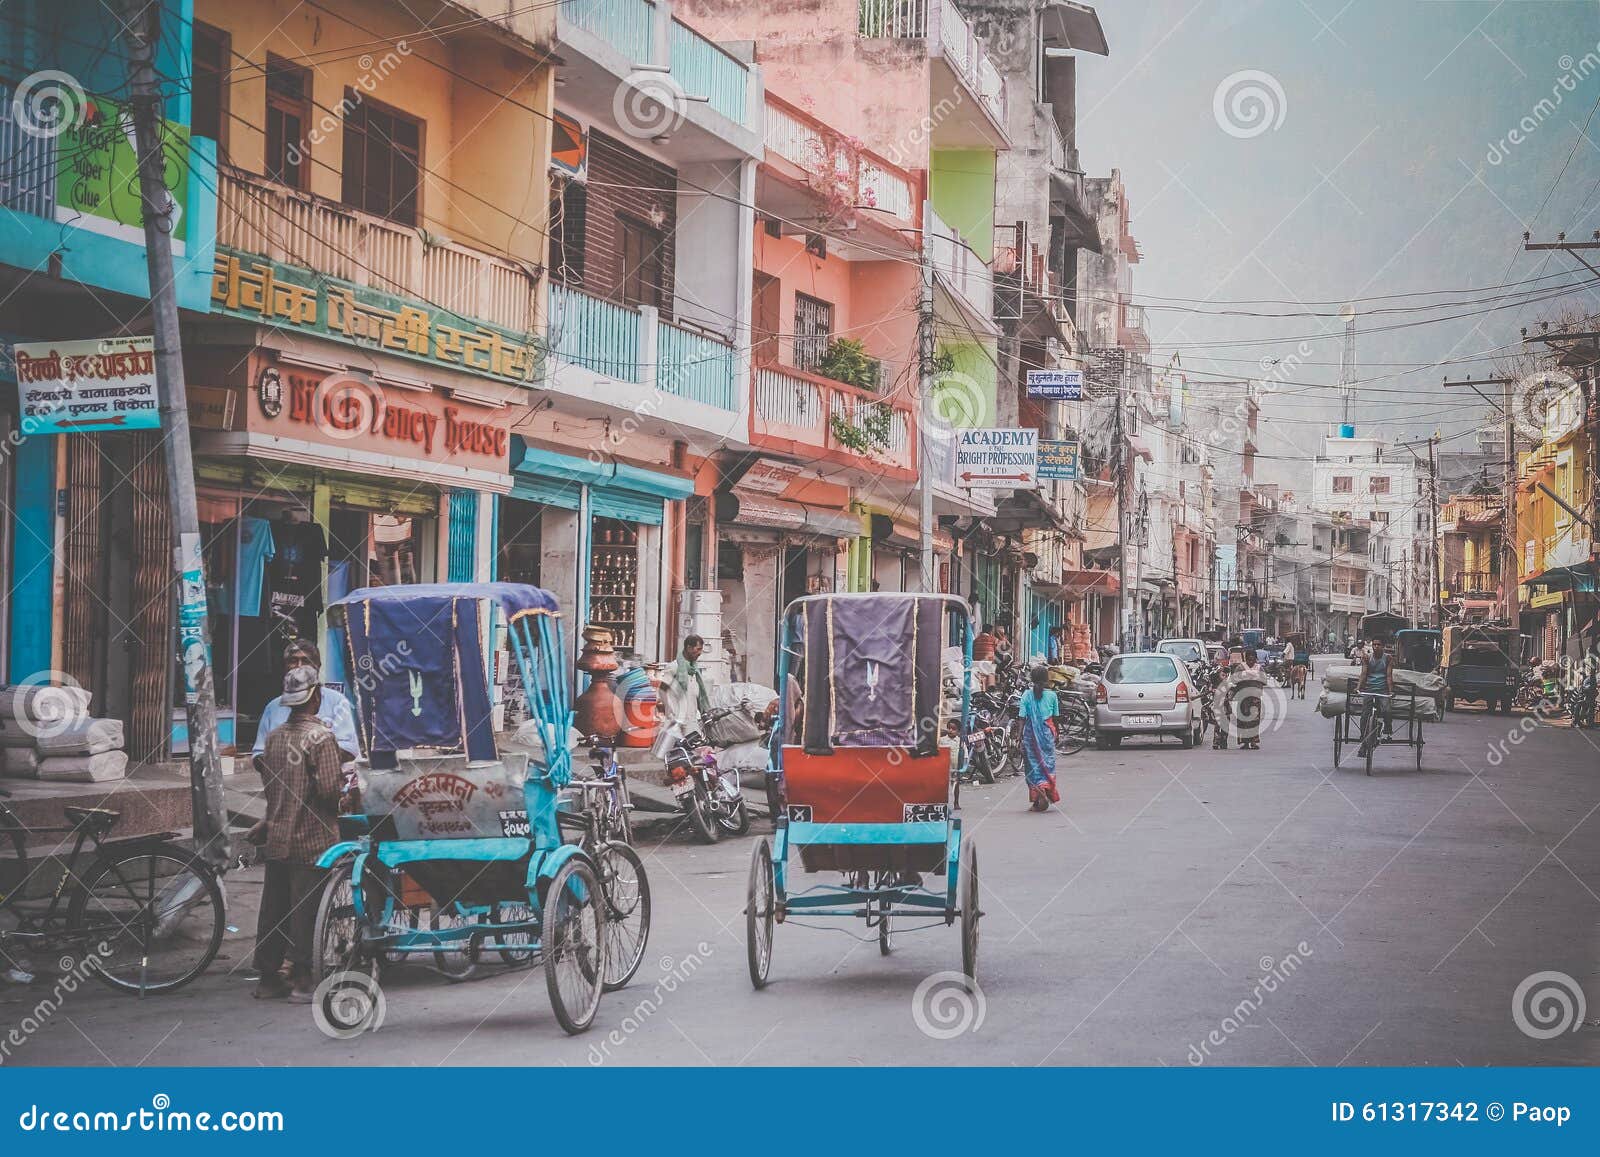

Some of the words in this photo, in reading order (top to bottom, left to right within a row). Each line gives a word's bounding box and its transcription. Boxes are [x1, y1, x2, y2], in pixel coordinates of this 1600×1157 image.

[72, 155, 103, 180] Super
[74, 182, 100, 207] Glue
[961, 431, 1035, 446] ACADEMY
[957, 452, 987, 464] BRIGHT
[988, 452, 1034, 466] PROFESSION
